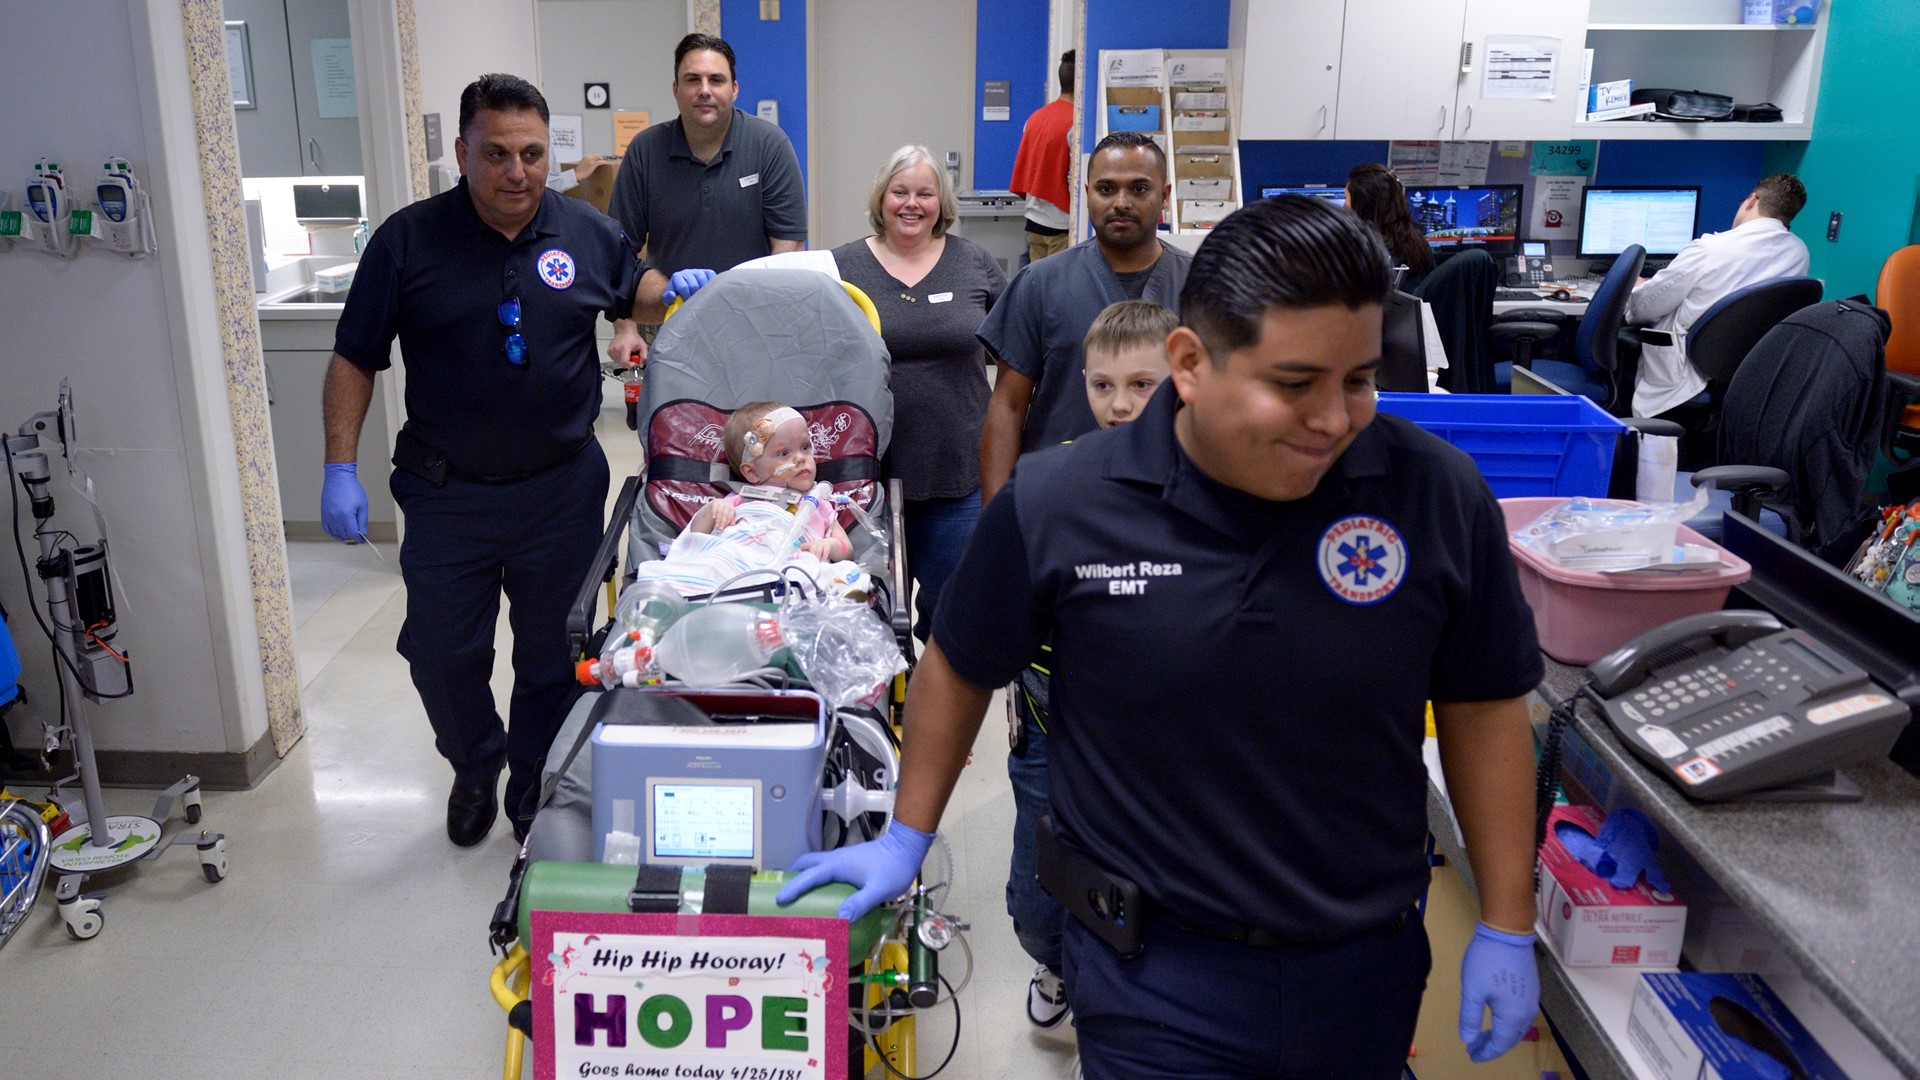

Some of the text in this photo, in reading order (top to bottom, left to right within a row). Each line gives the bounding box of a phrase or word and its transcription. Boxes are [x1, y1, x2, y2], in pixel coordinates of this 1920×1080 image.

[1600, 87, 1612, 96] TV
[1548, 145, 1581, 156] 34299
[1327, 518, 1398, 545] PEDIATRIC
[1075, 561, 1183, 579] Wilbert Reza
[1109, 580, 1148, 595] EMT
[1329, 576, 1396, 601] TRANSPORT
[62, 858, 124, 867] INTERPRETER
[93, 853, 130, 861] REMOTE
[592, 949, 786, 973] Hip Hip Hooray!
[574, 993, 809, 1052] HOPE
[579, 1062, 802, 1080] Goes home today 4/25/18!
